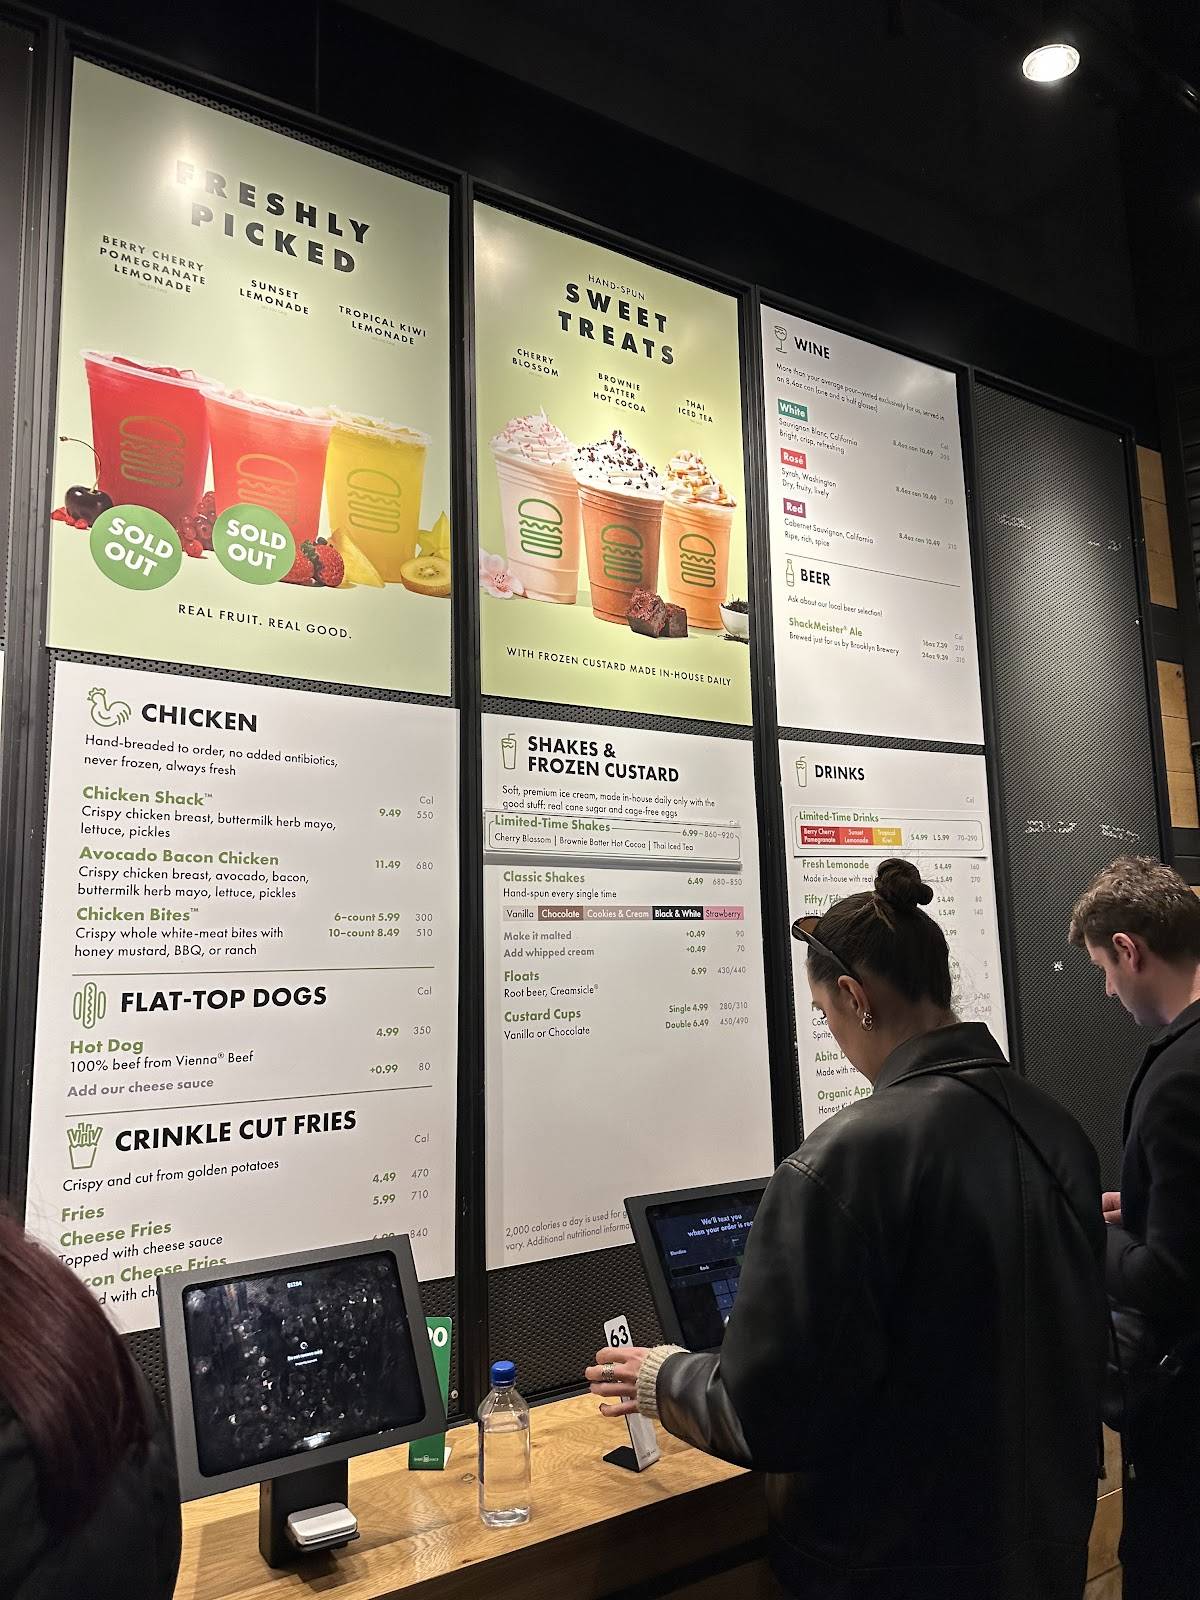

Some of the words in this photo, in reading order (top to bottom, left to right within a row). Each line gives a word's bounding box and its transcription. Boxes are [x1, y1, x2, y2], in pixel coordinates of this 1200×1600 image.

[176, 159, 370, 244] FRESHLY
[191, 202, 355, 273] PICKED
[102, 235, 145, 255] BERRY
[152, 250, 204, 271] CHERRY
[100, 247, 206, 285] POMEGRANATE
[114, 264, 192, 293] LEMONADE
[251, 280, 299, 300] SUNSET
[588, 274, 645, 300] HAND-SPUN
[240, 288, 308, 314] LEMONADE
[566, 283, 666, 332] SWEET
[339, 305, 395, 328] TROPICAL
[400, 323, 426, 337] KIWI
[352, 321, 415, 345] LEMONADE
[558, 311, 674, 364] TREATS
[794, 336, 830, 359] WINE
[517, 349, 553, 365] CHERRY
[512, 358, 558, 376] BLOSSOM
[599, 373, 640, 391] BROWNIE
[604, 385, 635, 399] BATTER
[593, 392, 611, 404] HOT
[615, 398, 646, 413] COCOA
[686, 400, 705, 411] THAI
[779, 403, 805, 417] White
[678, 407, 696, 419] ICED
[700, 413, 713, 423] TEA
[784, 451, 803, 465] Rosé
[786, 502, 803, 514] Red
[108, 517, 173, 559] SOLD
[226, 519, 286, 550] SOLD
[104, 541, 158, 576] OUT
[228, 543, 276, 570] OUT
[801, 569, 830, 586] BEER
[178, 604, 213, 618] REAL
[220, 610, 262, 625] FRUIT.
[269, 618, 300, 631] REAL
[306, 624, 352, 639] GOOD.
[850, 627, 863, 637] Ale
[507, 646, 534, 658] WITH
[539, 652, 578, 664] FROZEN
[583, 658, 625, 671] CUSTARD
[630, 665, 656, 675] MADE
[660, 669, 704, 682] IN-HOUSE
[708, 676, 731, 686] DAILY
[141, 704, 258, 732] CHICKEN
[85, 735, 174, 752] Hand-breaded
[177, 741, 188, 754] to
[193, 745, 226, 758] order,
[229, 749, 243, 758] no
[246, 748, 281, 762] added
[284, 753, 338, 767] antibiotics,
[528, 736, 598, 757] SHAKES
[604, 743, 616, 758] &
[528, 757, 599, 776] FROZEN
[605, 763, 679, 782] CUSTARD
[815, 765, 864, 780] DRINKS
[82, 786, 150, 802] Chicken
[81, 807, 121, 821] Crispy
[126, 808, 170, 821] chicken
[174, 811, 214, 825] breast,
[218, 812, 272, 826] buttermilk
[276, 815, 300, 828] herb
[304, 820, 336, 831] mayo,
[379, 808, 401, 817] 9.49
[417, 811, 433, 820] 550
[799, 812, 851, 821] Limited-Time
[854, 813, 878, 822] Drinks
[495, 815, 568, 829] Limited-Time
[572, 820, 610, 831] Shakes
[495, 833, 520, 844] Cherry
[522, 834, 551, 844] Blossom
[560, 837, 588, 846] Brownie
[590, 837, 609, 846] Batter
[611, 839, 623, 847] Hot
[625, 840, 646, 849] Cocoa
[79, 847, 158, 862] Avocado
[163, 850, 213, 864] Bacon
[218, 852, 279, 866] Chicken
[803, 860, 824, 869] Fresh
[827, 860, 869, 869] Lemonade
[375, 860, 400, 869] 11.49
[416, 861, 433, 870] 680
[504, 871, 542, 883] Classic
[545, 871, 585, 883] Shakes
[688, 877, 703, 885] 6.49
[76, 907, 145, 921] Chicken
[334, 912, 376, 922] 6-count
[378, 913, 400, 922] 5.99
[416, 913, 433, 922] 300
[507, 910, 534, 918] Vanilla
[542, 910, 580, 918] Chocolate
[587, 910, 618, 918] Cookies
[619, 910, 624, 918] &
[626, 910, 649, 918] Cream
[655, 910, 673, 918] Black
[675, 910, 680, 918] &
[682, 909, 701, 918] White
[706, 910, 740, 919] Strawberry
[328, 928, 374, 937] 10-count
[377, 928, 399, 938] 8.49
[416, 928, 432, 937] 510
[504, 971, 539, 982] Floats
[691, 967, 707, 975] 6.99
[718, 966, 746, 975] 430/440
[121, 989, 245, 1012] FLAT-TOP
[254, 987, 327, 1008] DOGS
[504, 1010, 550, 1022] Custard
[554, 1009, 581, 1021] Cups
[376, 1027, 399, 1037] 4.99
[413, 1026, 431, 1035] 350
[504, 1029, 534, 1040] Vanilla
[537, 1030, 546, 1038] or
[549, 1027, 590, 1037] Chocolate
[70, 1040, 103, 1054] Hot
[108, 1039, 144, 1055] Dog
[70, 1059, 108, 1073] 100%
[112, 1057, 140, 1070] beef
[144, 1056, 171, 1068] from
[228, 1051, 253, 1063] Beef
[815, 1051, 838, 1063] Abita
[116, 1122, 231, 1151] CRINKLE
[239, 1117, 287, 1140] CUT
[294, 1110, 356, 1134] FRIES
[372, 1172, 396, 1183] 4.49
[411, 1168, 429, 1179] 470
[372, 1194, 395, 1205] 5.99
[412, 1189, 428, 1200] 710
[61, 1206, 104, 1222] Fries
[60, 1229, 125, 1247] Cheese
[131, 1221, 171, 1238] Fries
[706, 1227, 719, 1236] your
[611, 1325, 629, 1347] 63
